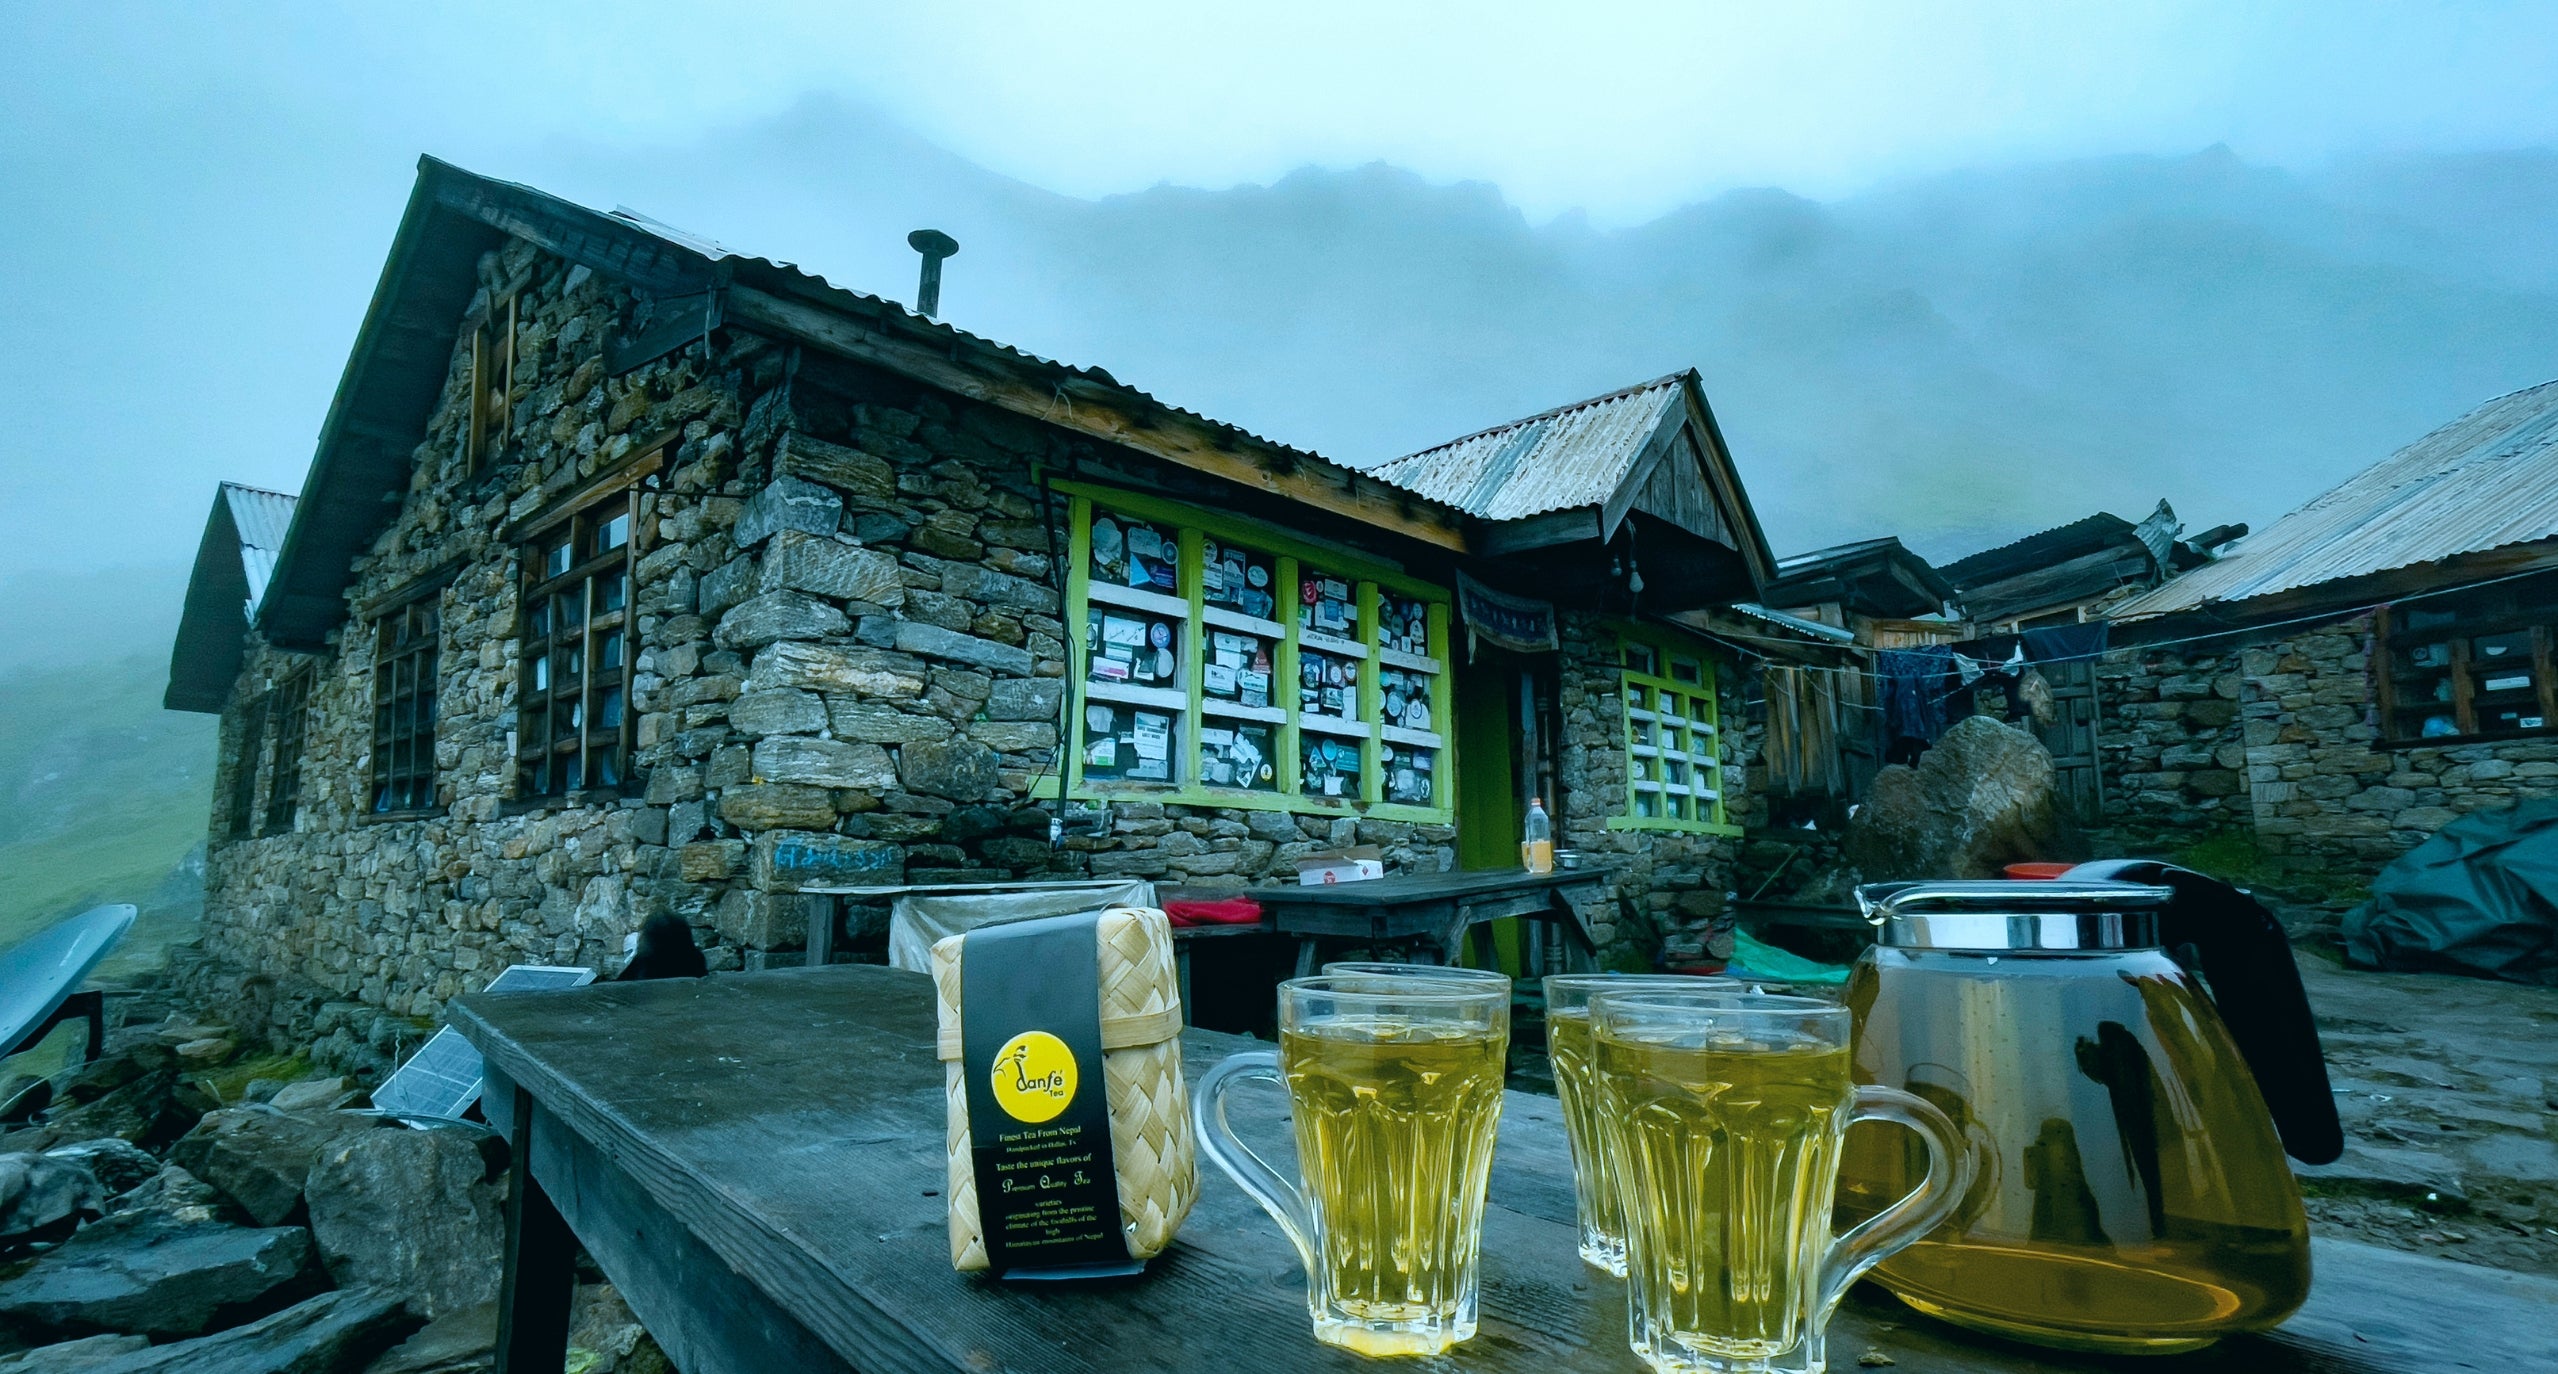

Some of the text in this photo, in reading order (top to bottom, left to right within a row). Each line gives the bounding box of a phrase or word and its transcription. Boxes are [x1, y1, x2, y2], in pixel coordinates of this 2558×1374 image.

[1049, 1090, 1064, 1098] Tea
[999, 1125, 1081, 1142] Finest Tea From Nepal
[995, 1152, 1093, 1172] Taste the unique flavors of
[1073, 1170, 1091, 1186] Tea
